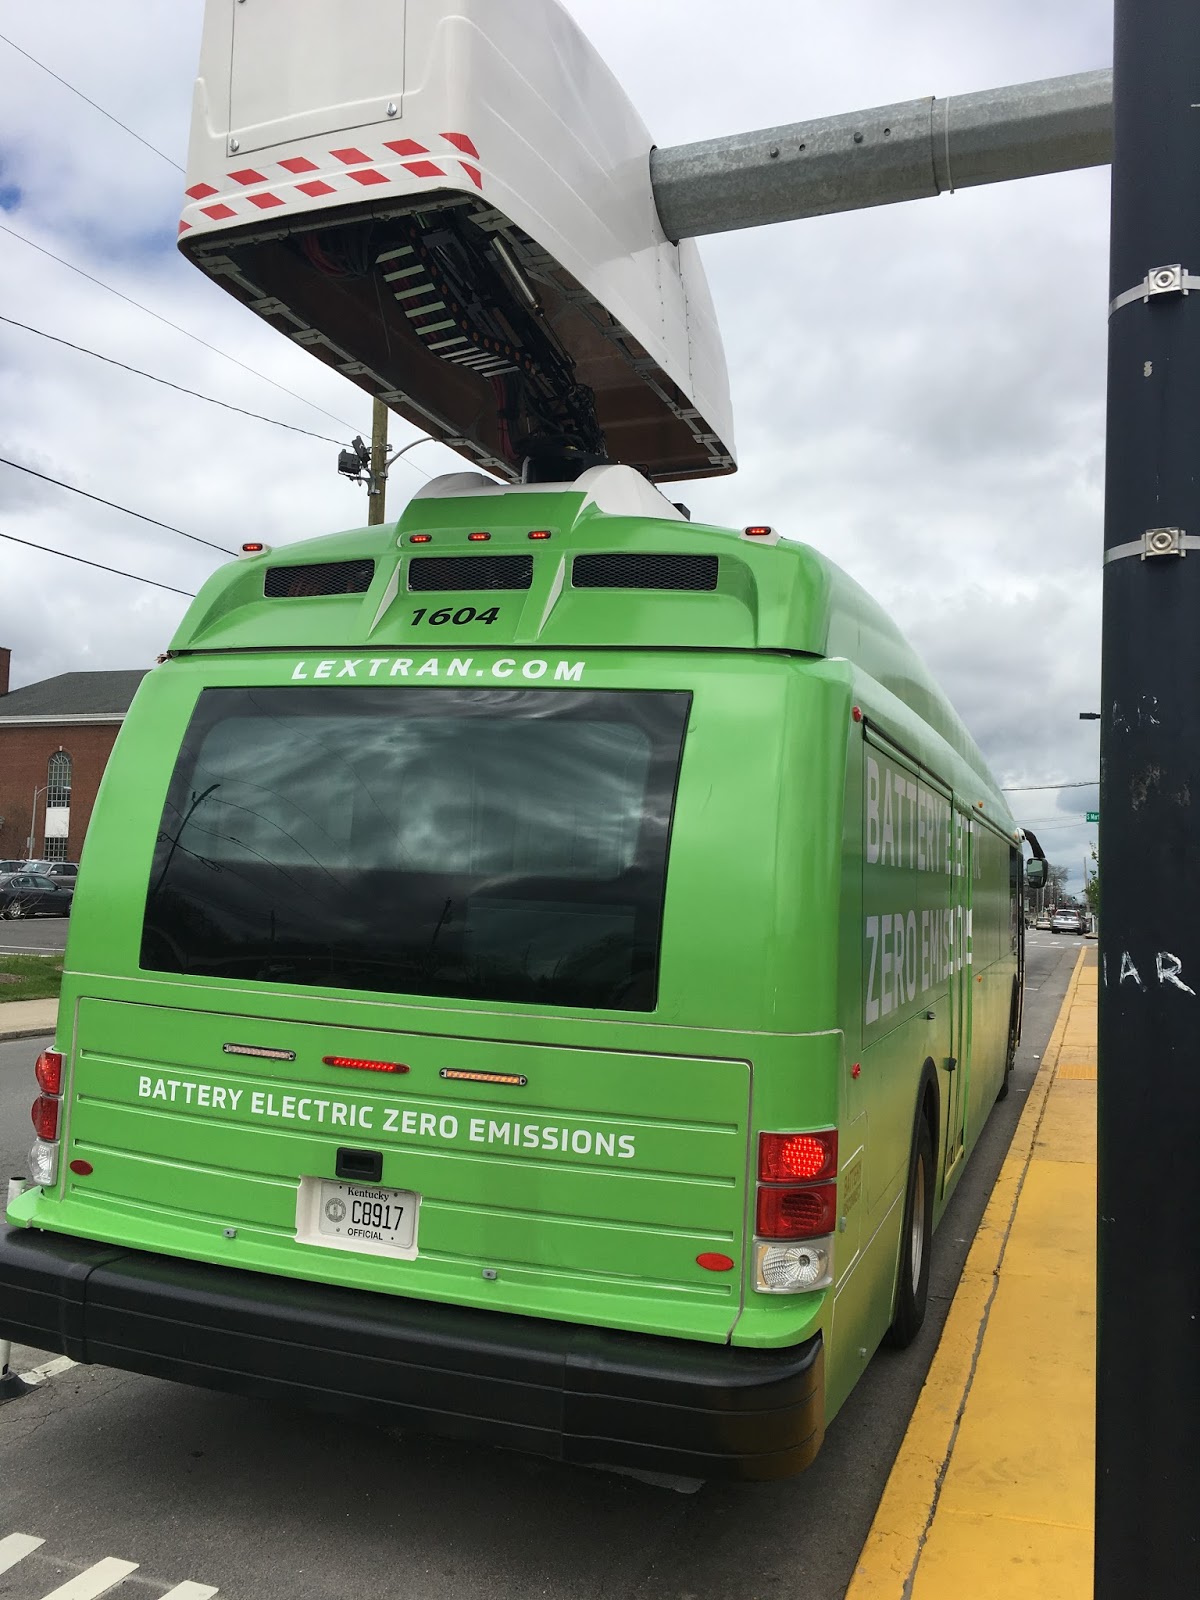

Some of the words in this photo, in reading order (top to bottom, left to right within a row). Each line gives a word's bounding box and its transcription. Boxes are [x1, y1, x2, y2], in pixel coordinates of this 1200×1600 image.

[410, 607, 500, 626] 1604
[291, 658, 586, 682] LEXTRAN.COM
[866, 756, 942, 873] BATTERY
[865, 909, 917, 1026] ZERO
[138, 1076, 243, 1111] BATTERY
[251, 1092, 374, 1129] ELECTRIC
[382, 1108, 459, 1139] ZERO
[469, 1118, 636, 1159] EMISSIONS
[347, 1186, 390, 1203] Kentucky
[351, 1200, 404, 1231] C8917
[347, 1227, 383, 1241] OFFICIAL
